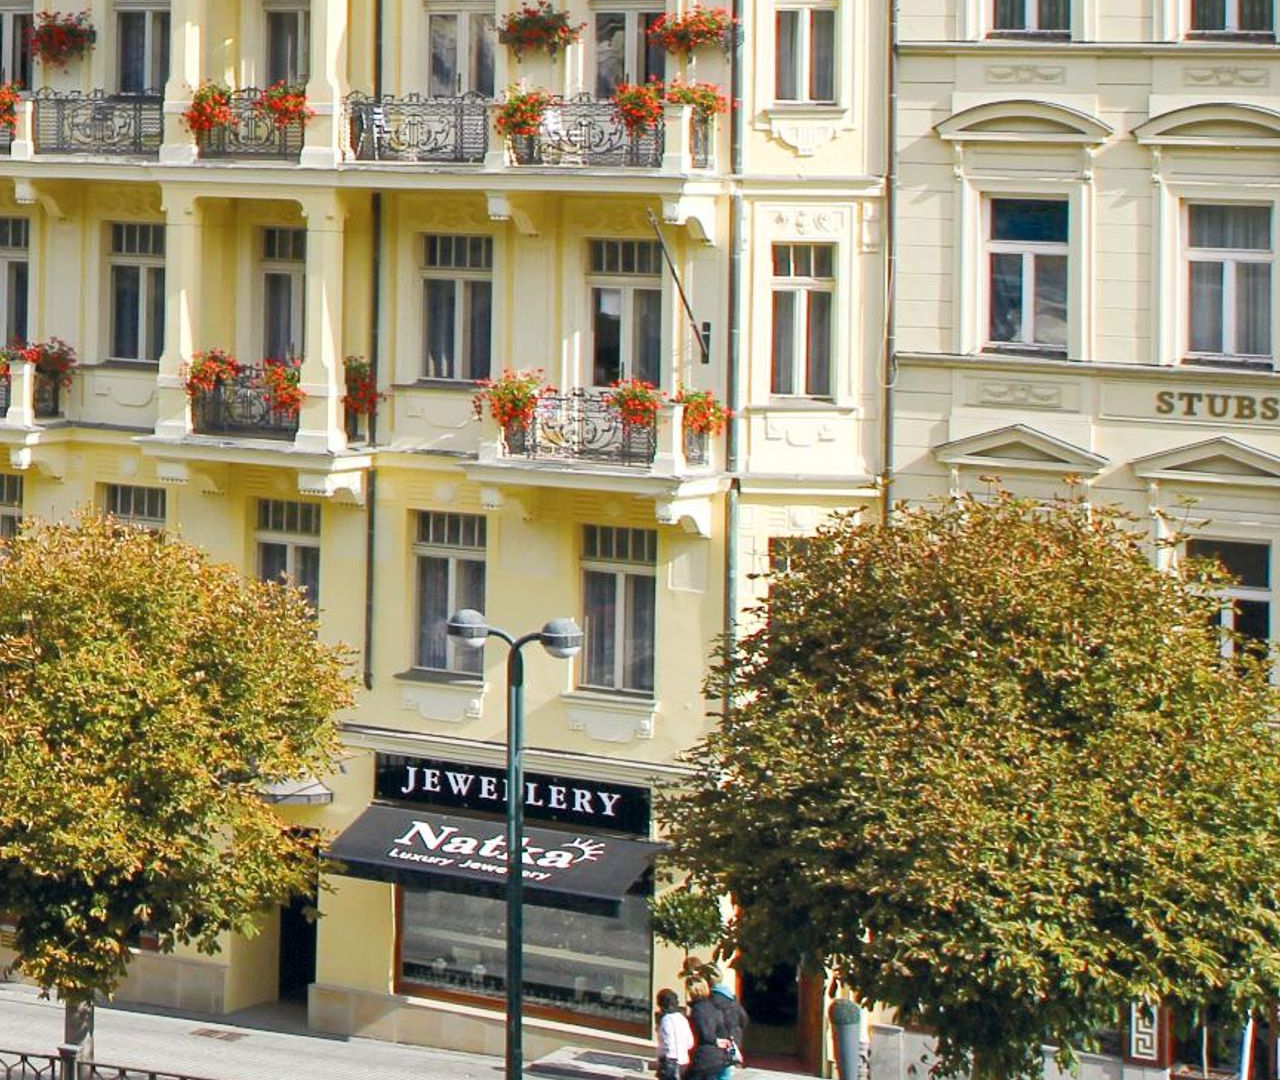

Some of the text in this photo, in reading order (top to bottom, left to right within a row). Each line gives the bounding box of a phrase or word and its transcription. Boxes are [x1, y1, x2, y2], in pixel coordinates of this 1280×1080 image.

[401, 765, 622, 817] JEWELERY
[388, 848, 553, 881] Luxury Jeweery
